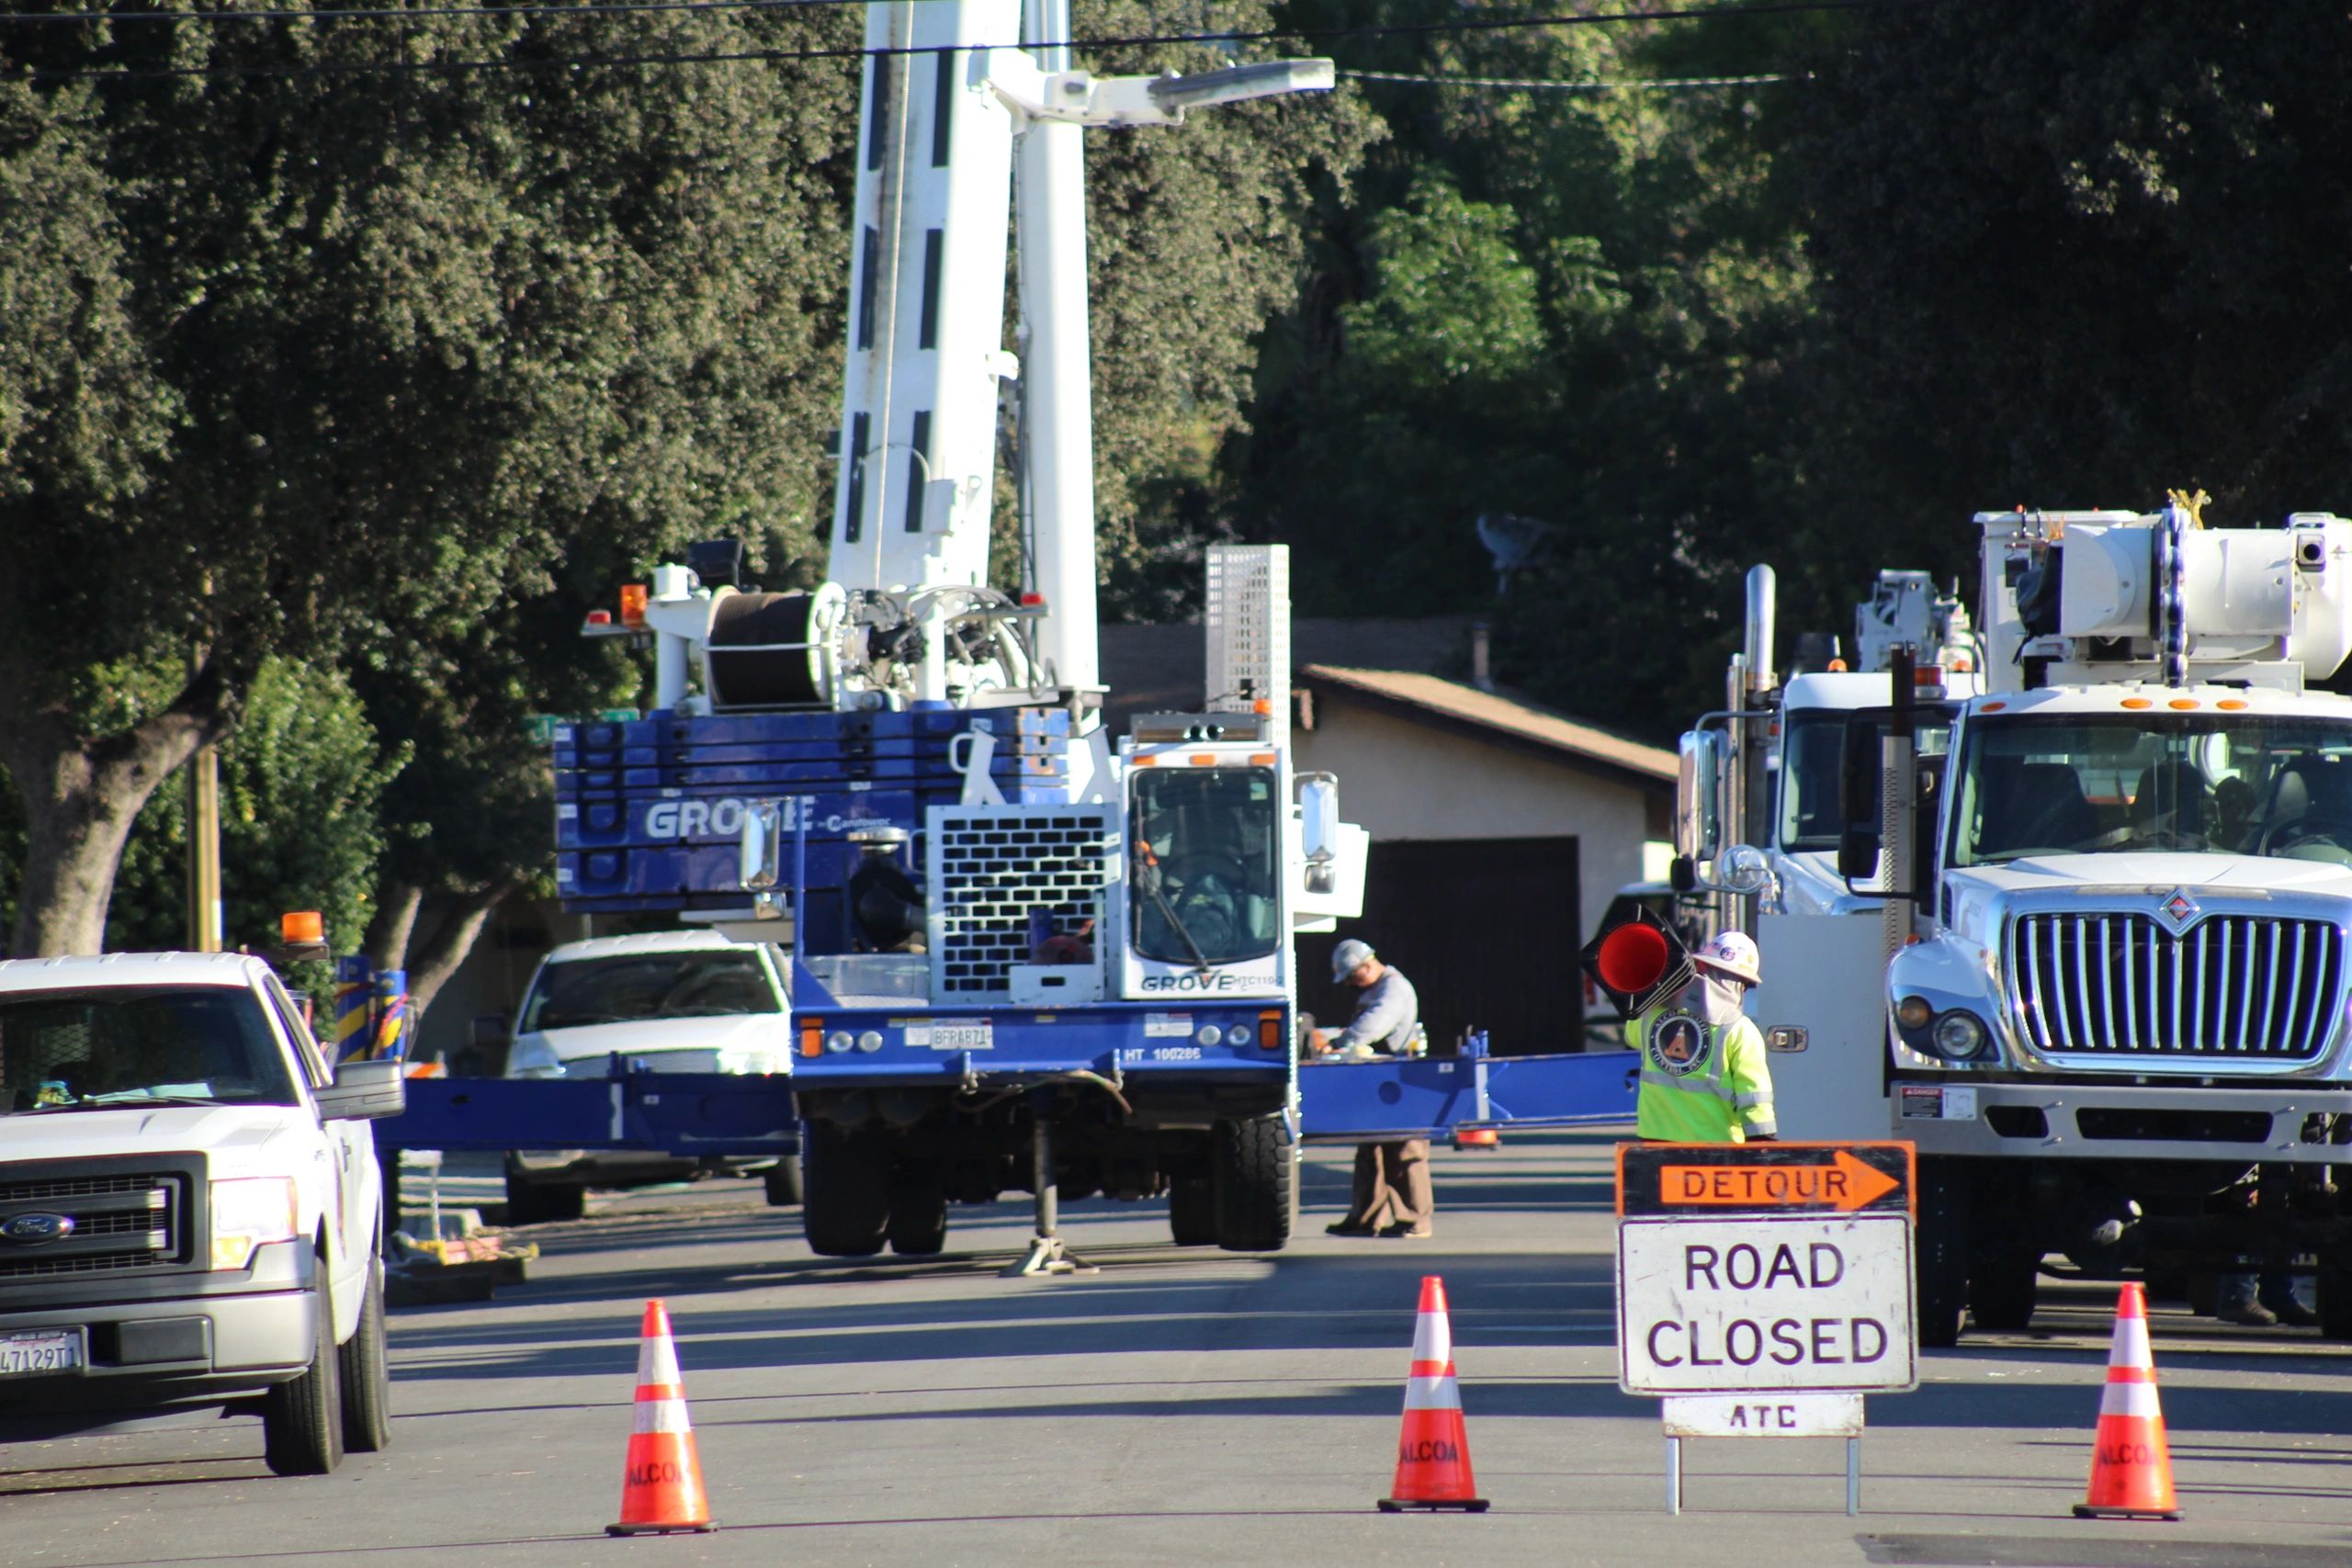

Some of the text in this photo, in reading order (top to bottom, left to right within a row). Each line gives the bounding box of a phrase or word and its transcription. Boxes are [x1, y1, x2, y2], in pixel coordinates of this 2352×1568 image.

[1141, 970, 1234, 991] GROVE
[1683, 1169, 1849, 1200] DETOUR
[14, 1218, 51, 1234] Ford
[1684, 1242, 1846, 1292] ROAD
[1647, 1316, 1889, 1368] CLOSED
[0, 1347, 76, 1372] 47129T1
[1730, 1404, 1797, 1429] ATC
